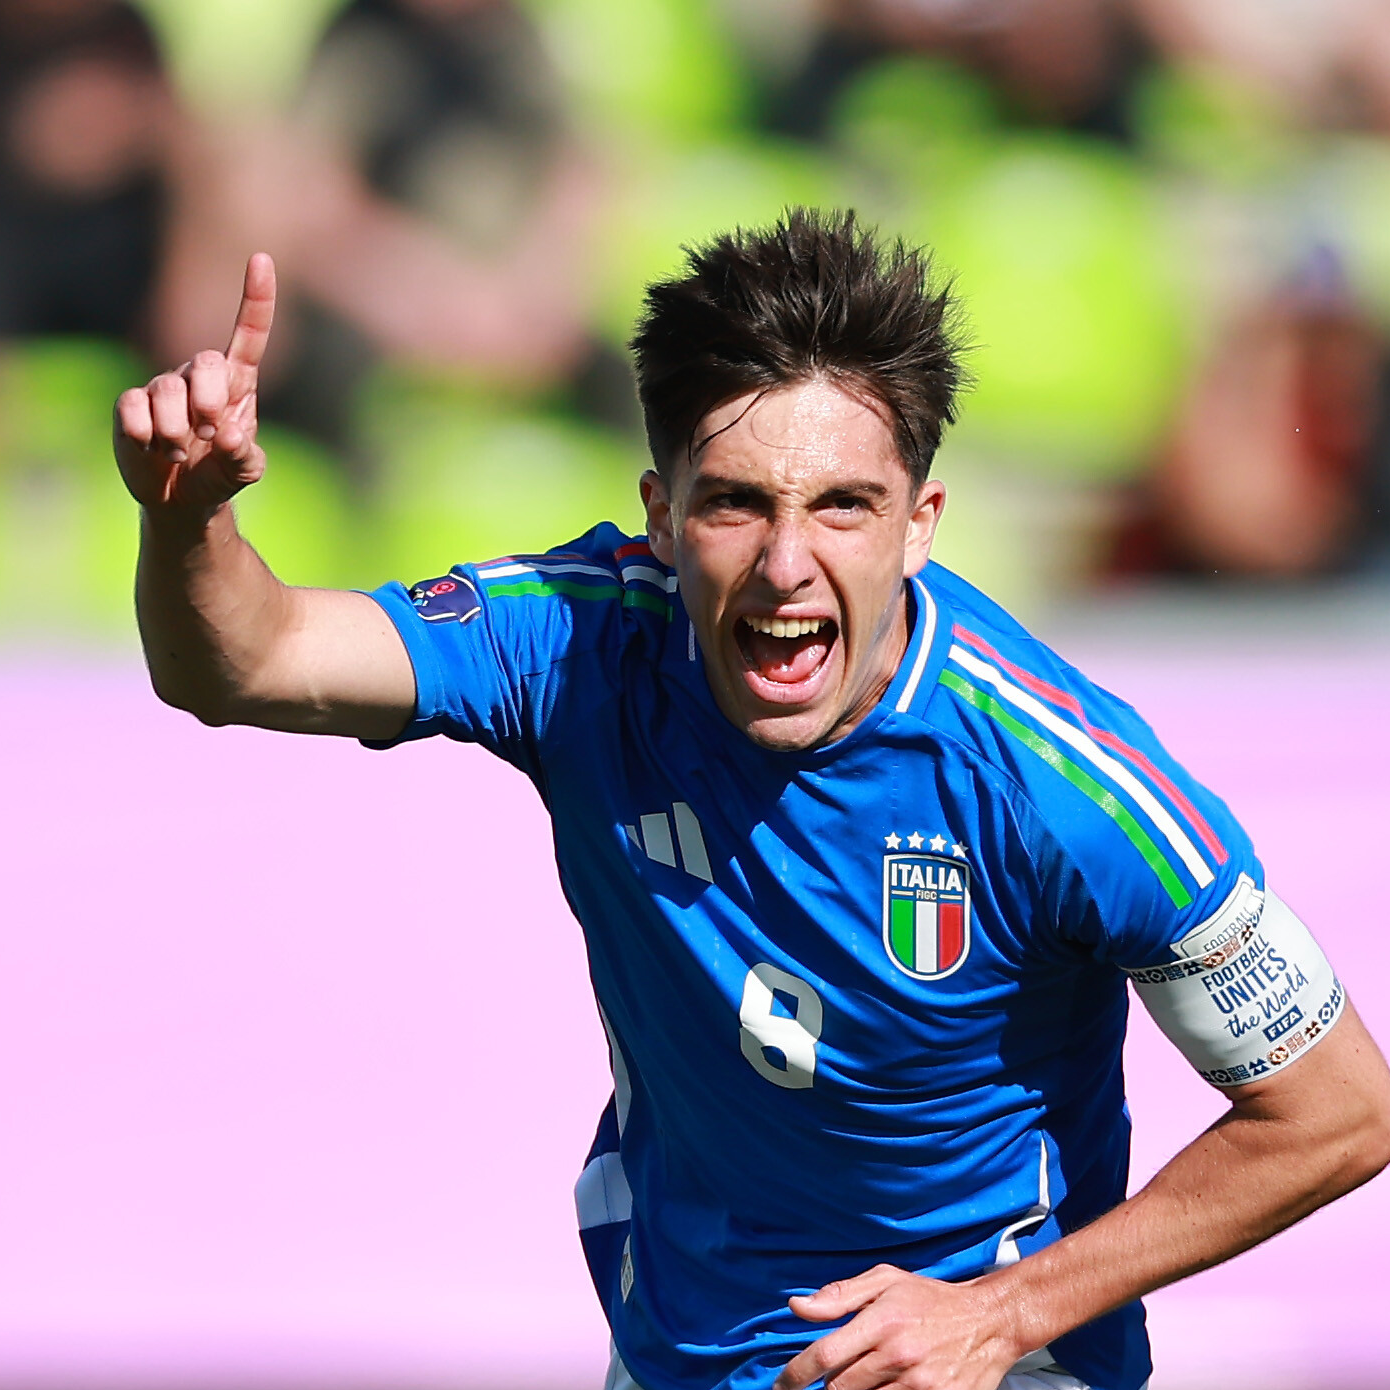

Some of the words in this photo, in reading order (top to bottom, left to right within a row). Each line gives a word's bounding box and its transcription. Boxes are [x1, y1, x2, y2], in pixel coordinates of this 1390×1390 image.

[891, 863, 963, 892] ITALIA
[1201, 934, 1270, 992] FOOTBALL
[1210, 947, 1288, 1014] UNITES
[739, 962, 823, 1089] 8
[1224, 1011, 1261, 1038] the
[1261, 963, 1309, 1020] World
[1268, 1009, 1303, 1041] FIFA
